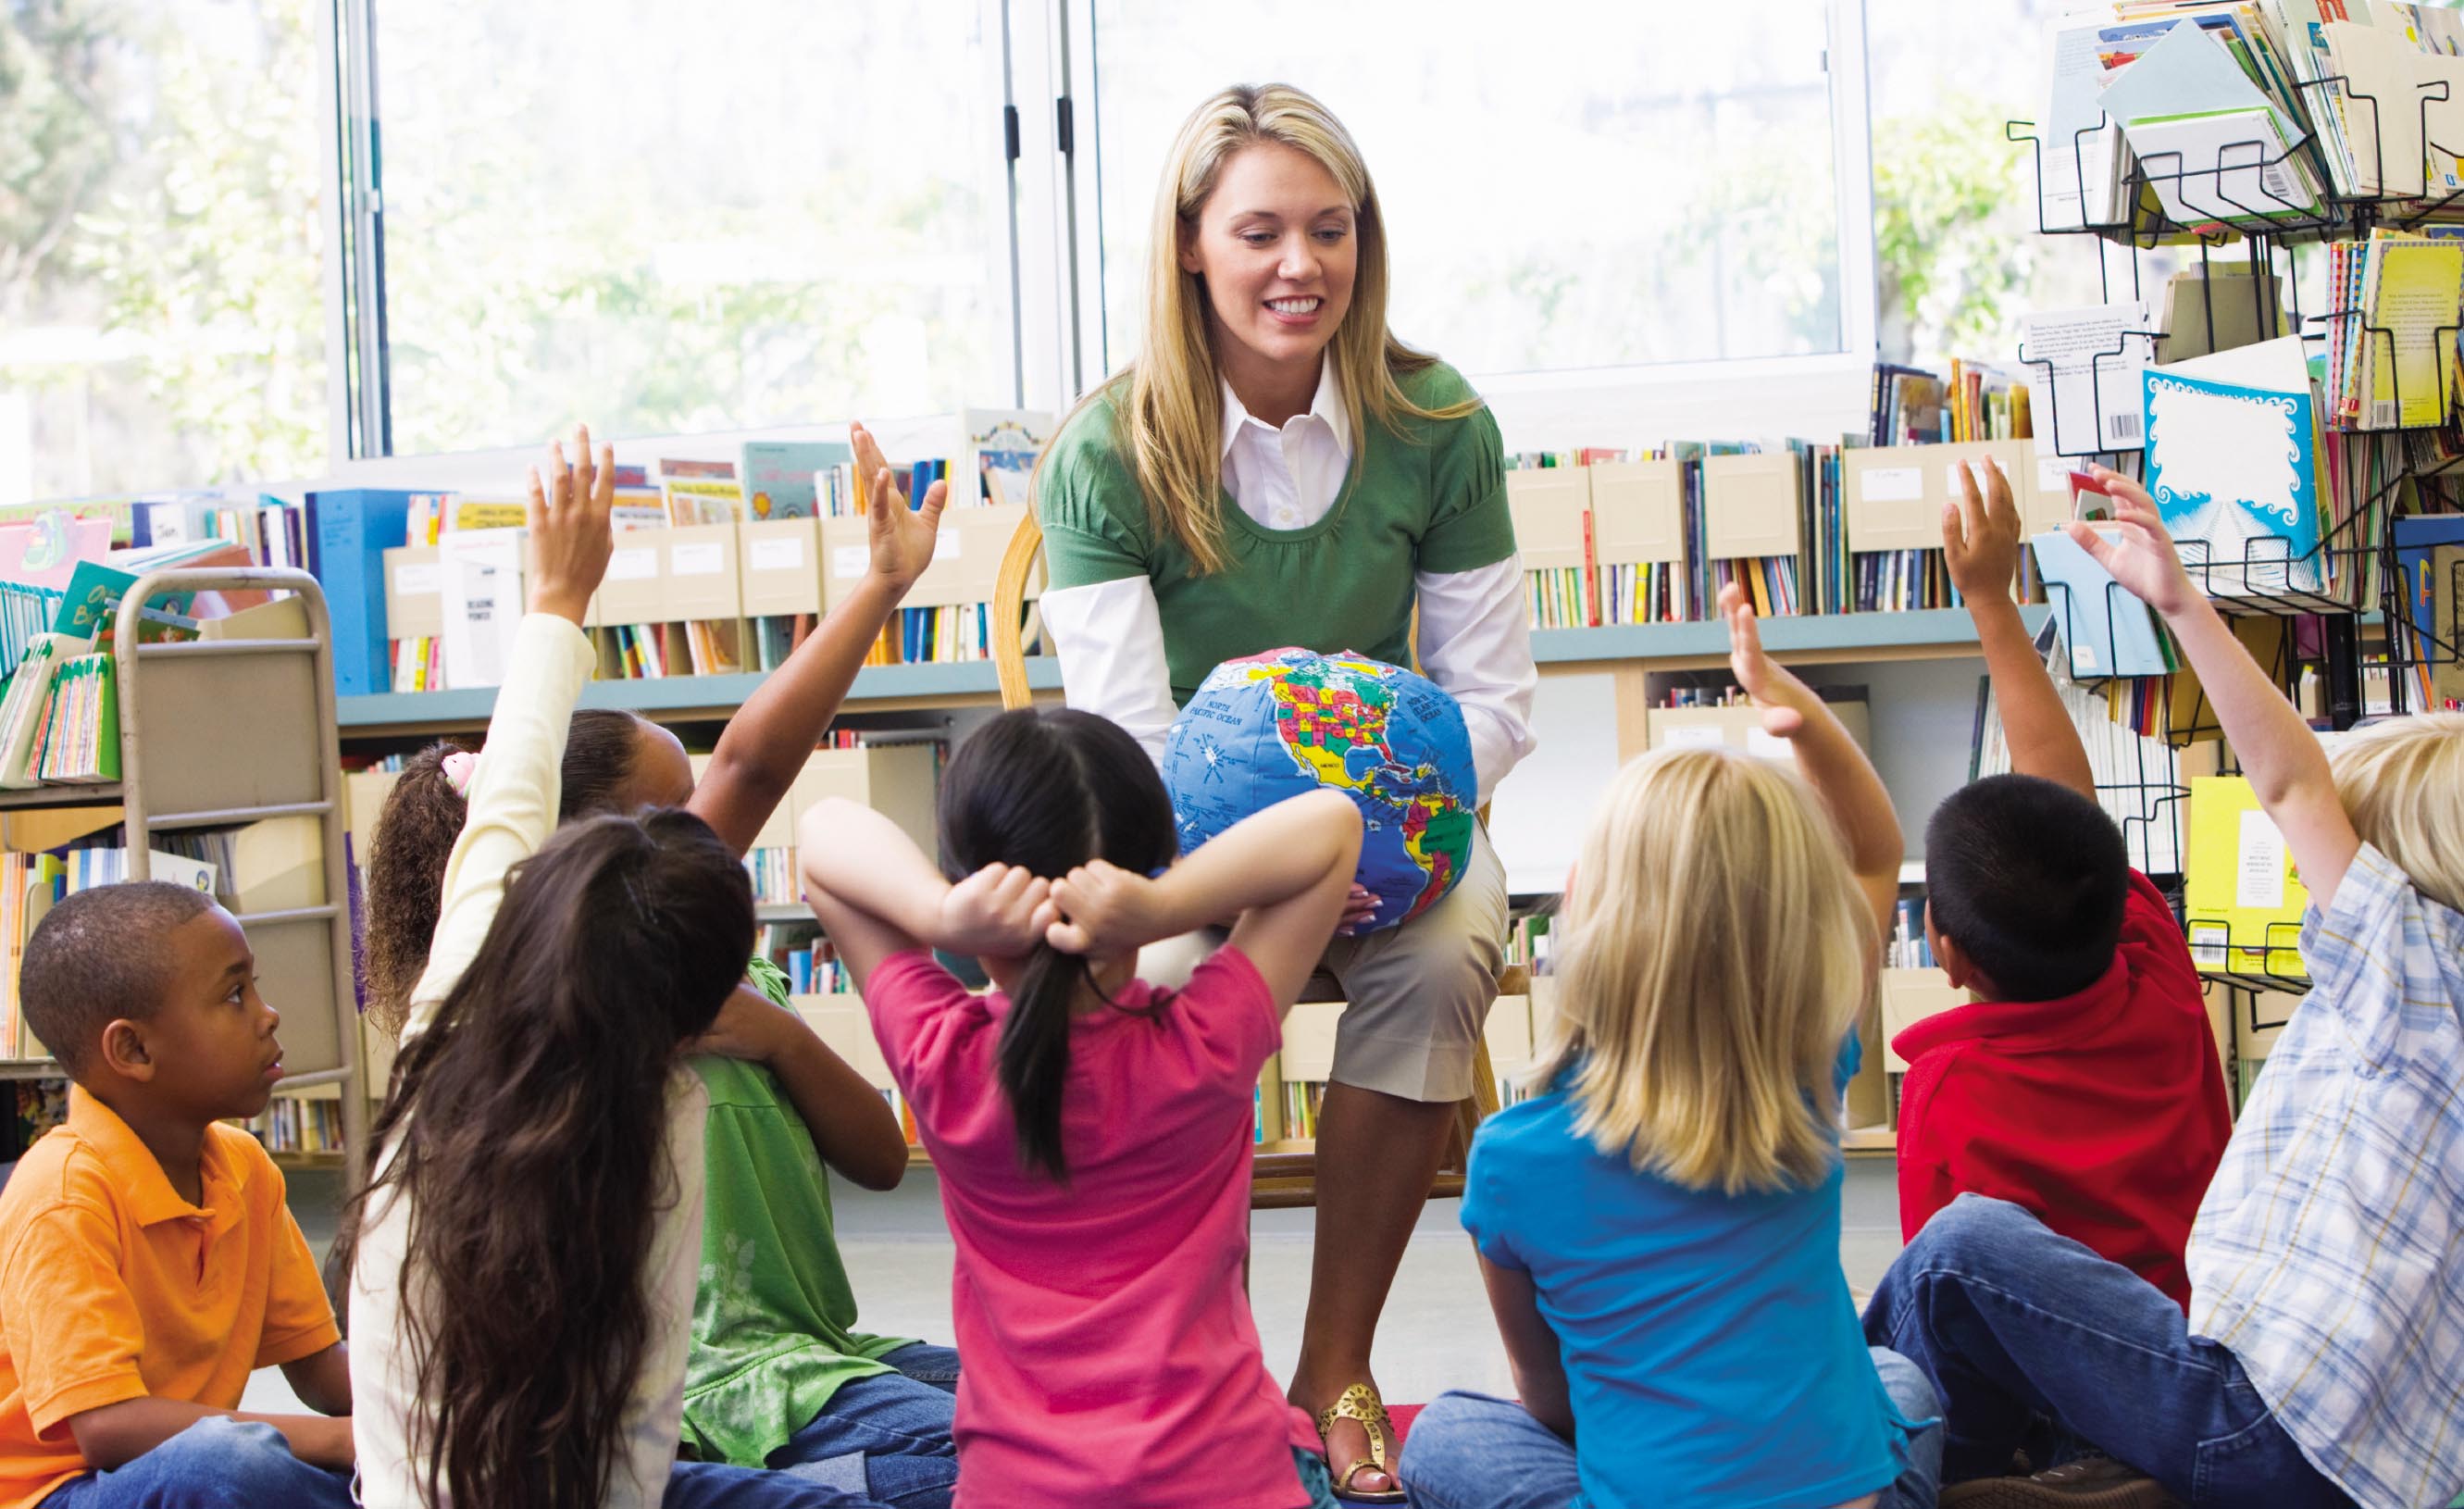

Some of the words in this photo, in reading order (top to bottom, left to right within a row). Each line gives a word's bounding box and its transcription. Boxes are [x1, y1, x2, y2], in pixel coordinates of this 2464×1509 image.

[1208, 701, 1231, 712] NORTH
[1189, 706, 1215, 718] PACIFIC
[1216, 713, 1243, 726] OCEAN
